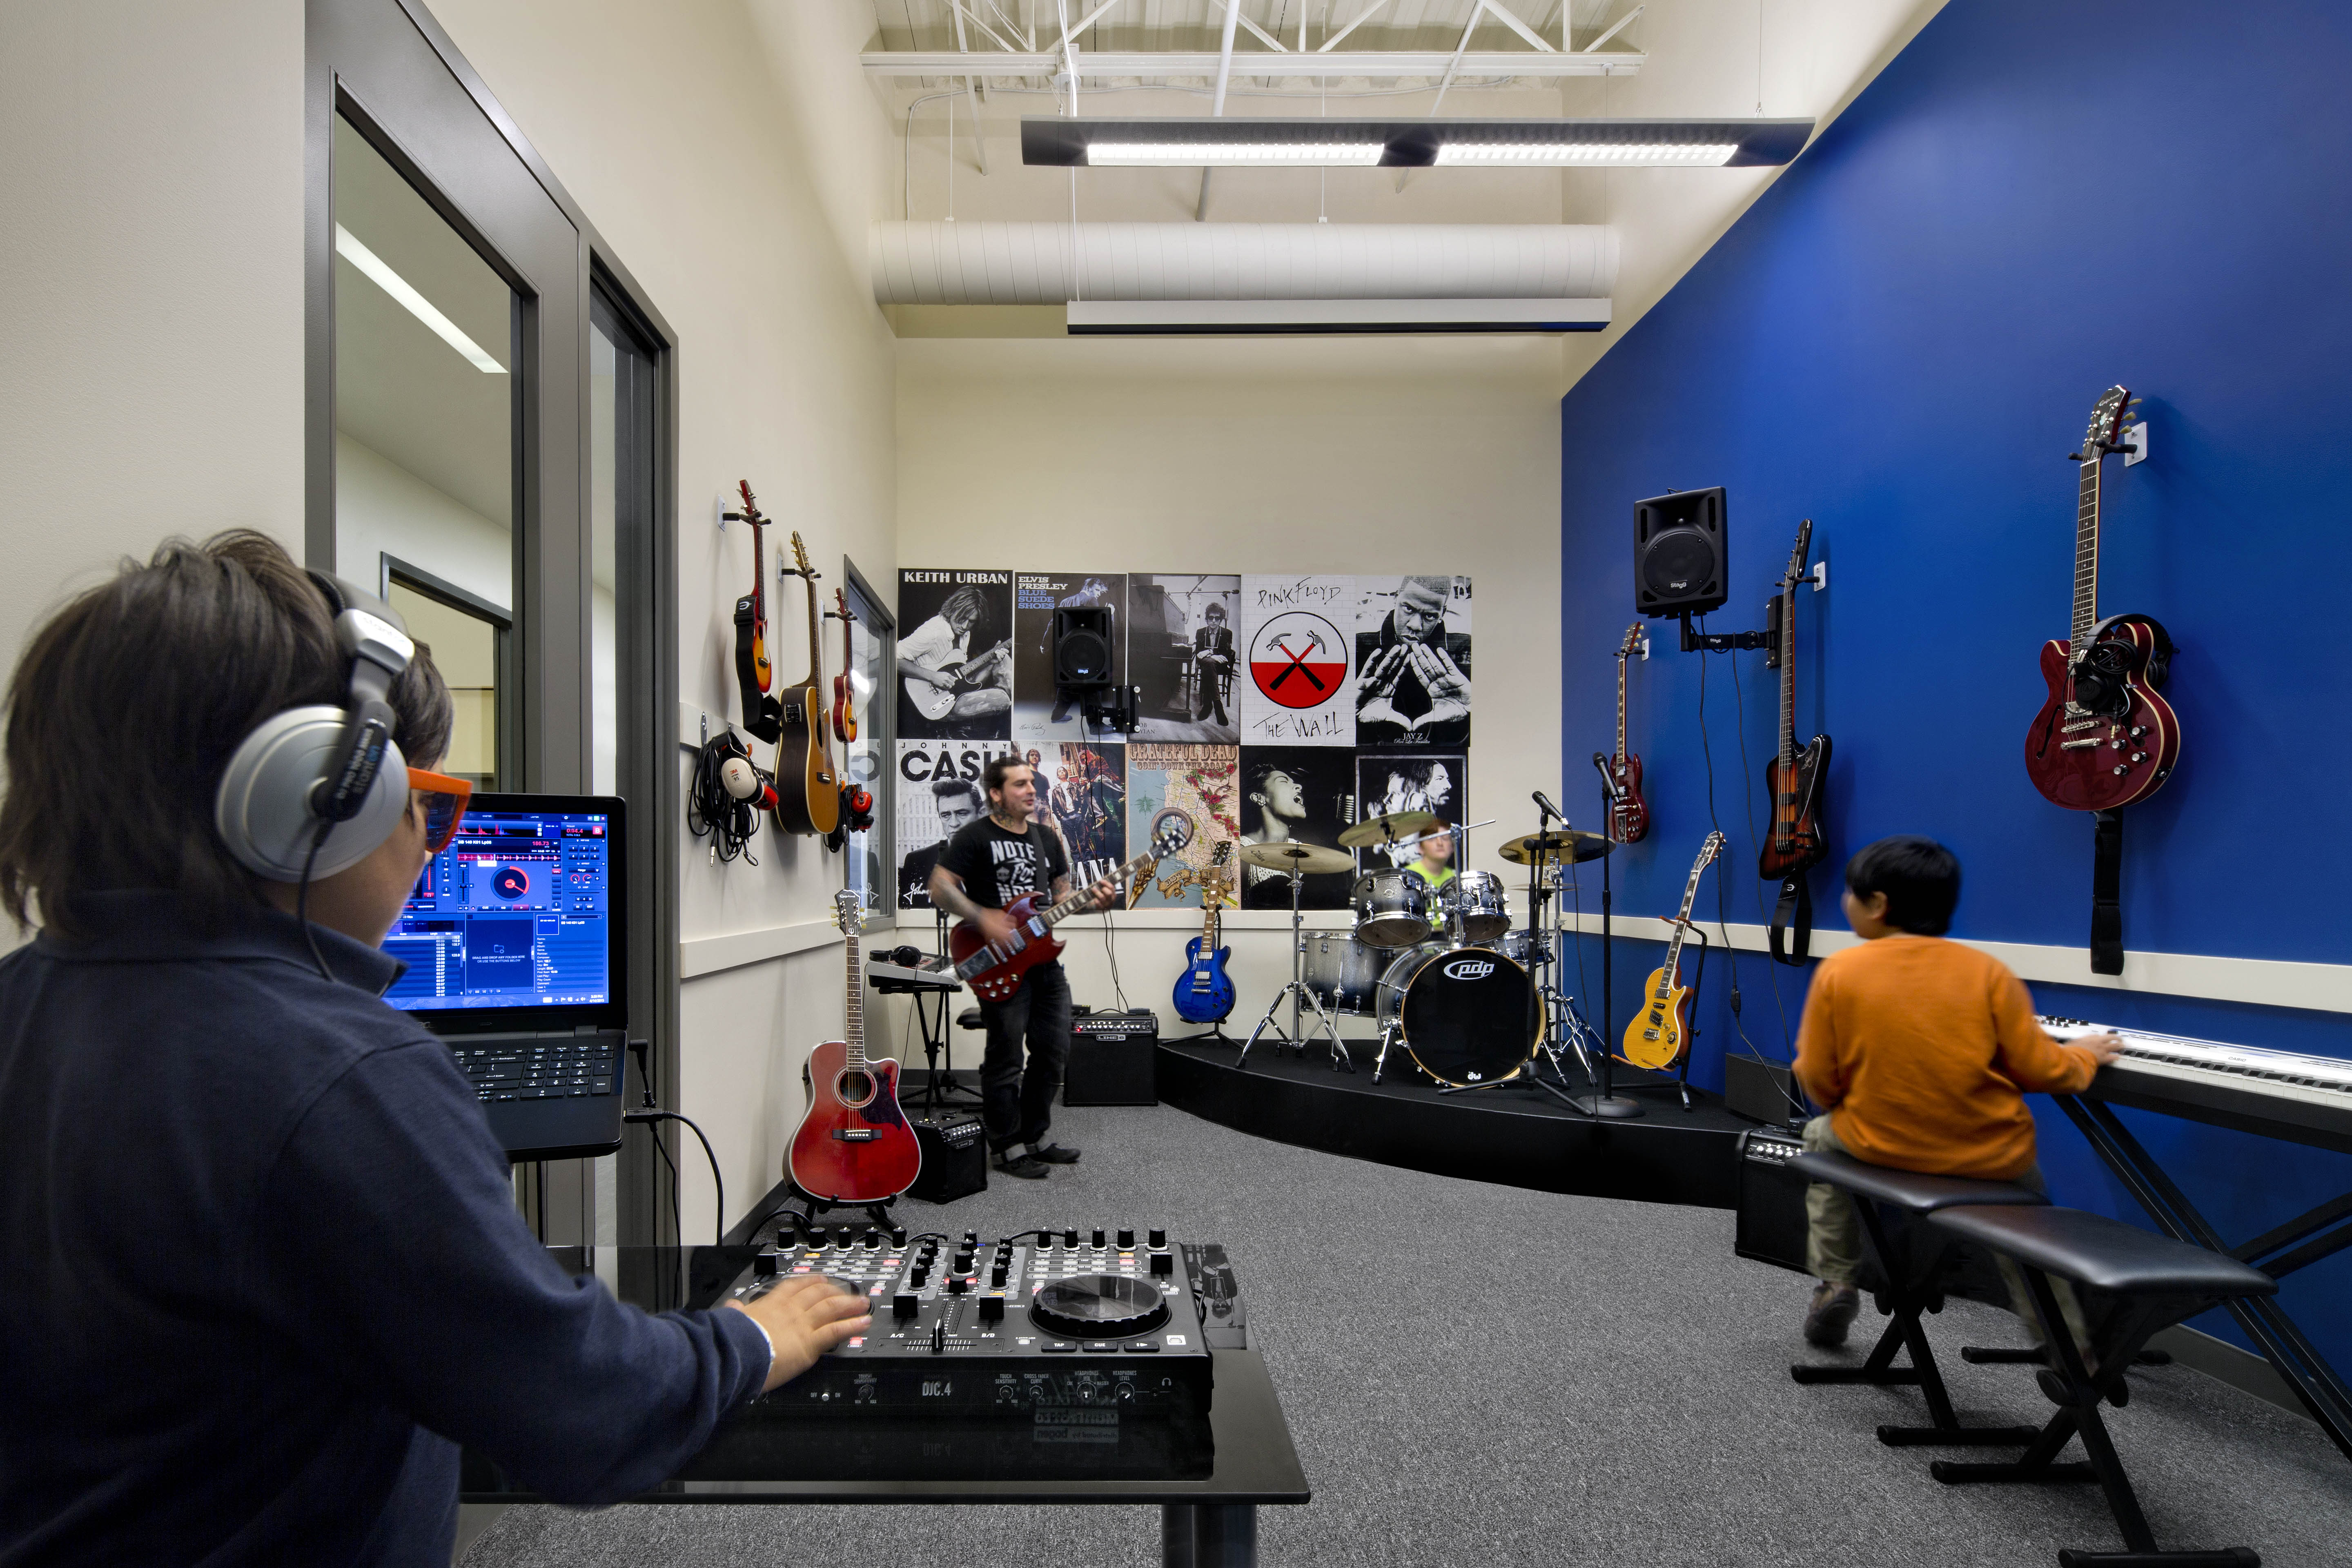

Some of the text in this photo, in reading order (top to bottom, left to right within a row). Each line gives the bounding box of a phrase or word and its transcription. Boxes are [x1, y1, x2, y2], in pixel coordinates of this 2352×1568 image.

[904, 572, 1008, 584] KEITH URBAN
[1258, 577, 1341, 609] PINK FLOYD
[1253, 711, 1344, 739] THE WALL
[1129, 744, 1237, 762] GRATEFUL DEAD
[1136, 762, 1159, 771] GOIN'
[1160, 762, 1185, 771] DOWN
[1185, 762, 1202, 771] THE
[922, 1382, 951, 1396] DJC.4
